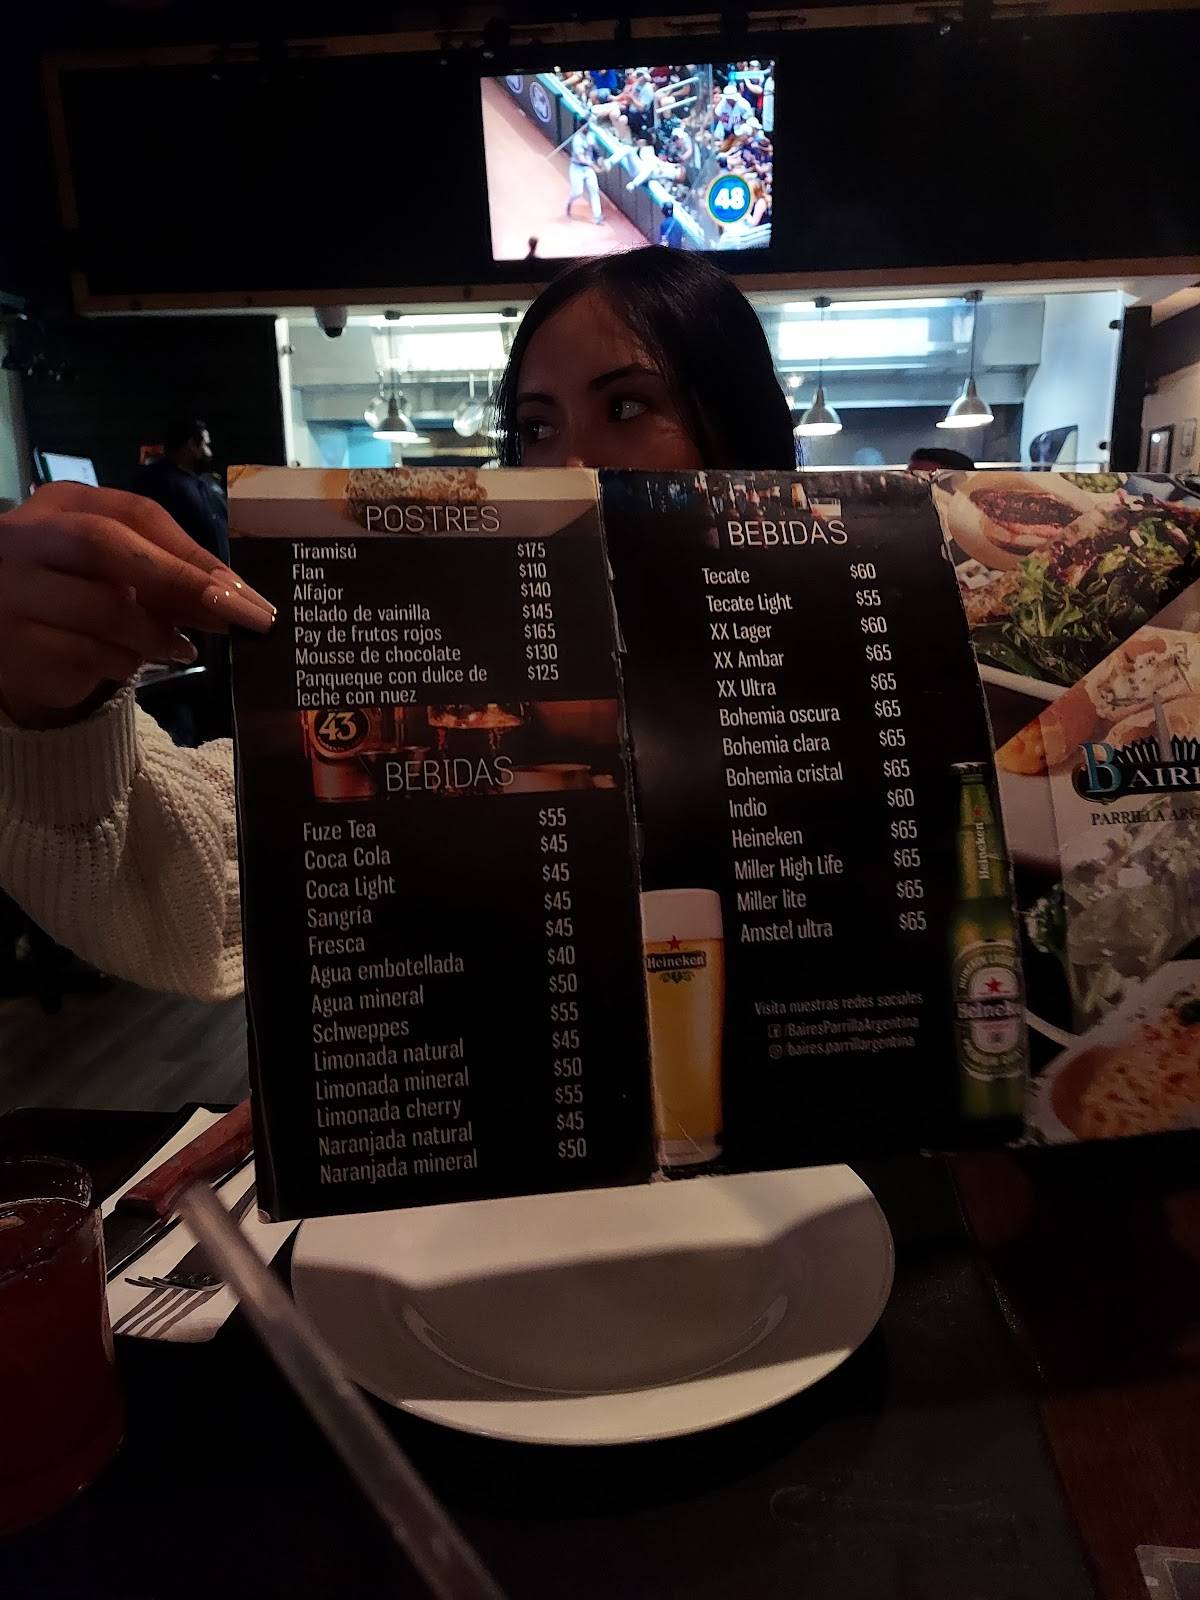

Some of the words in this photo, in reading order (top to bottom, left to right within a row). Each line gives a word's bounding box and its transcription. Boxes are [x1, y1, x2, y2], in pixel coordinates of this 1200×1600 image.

[714, 187, 745, 210] 48
[366, 504, 500, 533] POSTRES
[727, 520, 849, 546] BEBIDAS
[292, 542, 357, 560] Tiramisú
[517, 542, 546, 559] $175
[292, 564, 325, 580] Flan
[518, 563, 547, 579] $110
[702, 567, 750, 585] Tecate
[850, 563, 877, 580] $60
[293, 584, 344, 605] Alfajor
[520, 582, 551, 599] $140
[856, 589, 881, 607] $55
[294, 605, 347, 623] Helado
[353, 605, 373, 622] de
[377, 604, 430, 622] vainilla
[522, 603, 553, 620] $145
[706, 595, 754, 612] Tecate
[757, 593, 793, 615] Light
[523, 624, 556, 640] $165
[709, 624, 729, 640] XX
[733, 623, 772, 644] Lager
[860, 616, 887, 634] $60
[294, 626, 321, 647] Pay
[327, 626, 347, 643] de
[351, 625, 398, 643] frutos
[404, 627, 442, 646] rojos
[295, 648, 355, 665] Mousse
[360, 647, 380, 664] de
[385, 646, 461, 664] chocolate
[525, 644, 558, 660] $130
[713, 652, 734, 669] XX
[737, 649, 785, 668] Ambar
[866, 644, 892, 662] $65
[296, 670, 383, 690] Panqueque
[388, 670, 417, 685] con
[422, 666, 464, 684] dulce
[469, 665, 488, 682] de
[527, 665, 559, 681] $125
[870, 672, 897, 691] $65
[297, 689, 341, 707] leche
[345, 690, 375, 705] con
[380, 689, 417, 704] nuez
[717, 681, 738, 697] XX
[741, 678, 777, 697] Ultra
[720, 706, 786, 727] Bohemia
[789, 706, 841, 724] oscura
[874, 700, 901, 718] $65
[319, 712, 357, 741] 43
[722, 736, 789, 756] Bohemia
[793, 734, 831, 753] clara
[879, 729, 906, 747] $65
[386, 756, 514, 793] BEBIDAS
[725, 767, 793, 788] Bohemia
[796, 762, 844, 783] cristal
[883, 759, 911, 778] $65
[887, 788, 915, 808] $60
[538, 807, 567, 827] $55
[729, 799, 768, 819] Indio
[303, 821, 342, 843] Fuze
[347, 820, 377, 839] Tea
[732, 828, 803, 849] Heineken
[890, 820, 918, 840] $65
[540, 834, 568, 854] $45
[975, 822, 990, 879] Heineken
[304, 849, 348, 870] Coca
[353, 846, 391, 867] Cola
[734, 860, 775, 881] Miller
[780, 856, 813, 882] High
[817, 854, 844, 876] Life
[893, 848, 921, 869] $65
[542, 862, 570, 883] $45
[305, 879, 349, 900] Coca
[355, 875, 396, 900] Light
[896, 879, 924, 900] $65
[544, 891, 572, 911] $45
[737, 892, 777, 912] Miller
[307, 905, 373, 931] Sangría
[545, 917, 574, 938] $45
[899, 911, 927, 932] $65
[740, 921, 794, 944] Amstel
[797, 918, 833, 939] ultra
[308, 936, 366, 957] Fresca
[547, 945, 576, 966] $40
[310, 966, 352, 989] Agua
[358, 952, 465, 981] embotellada
[647, 954, 705, 969] Heineken
[548, 973, 578, 994] $50
[311, 994, 354, 1018] Agua
[359, 984, 424, 1009] mineral
[550, 1002, 579, 1022] $55
[312, 1019, 410, 1045] Schweppes
[551, 1029, 580, 1050] $45
[314, 1046, 398, 1073] Limonada
[403, 1037, 464, 1063] natural
[553, 1057, 583, 1078] $50
[315, 1074, 400, 1101] Limonada
[404, 1066, 470, 1092] mineral
[555, 1084, 584, 1105] $55
[316, 1102, 401, 1129] Limonada
[406, 1097, 462, 1121] cherry
[556, 1111, 585, 1131] $45
[318, 1129, 407, 1158] Naranjada
[412, 1121, 473, 1147] natural
[557, 1138, 587, 1159] $50
[320, 1156, 409, 1185] Naranjada
[413, 1149, 478, 1175] mineral
